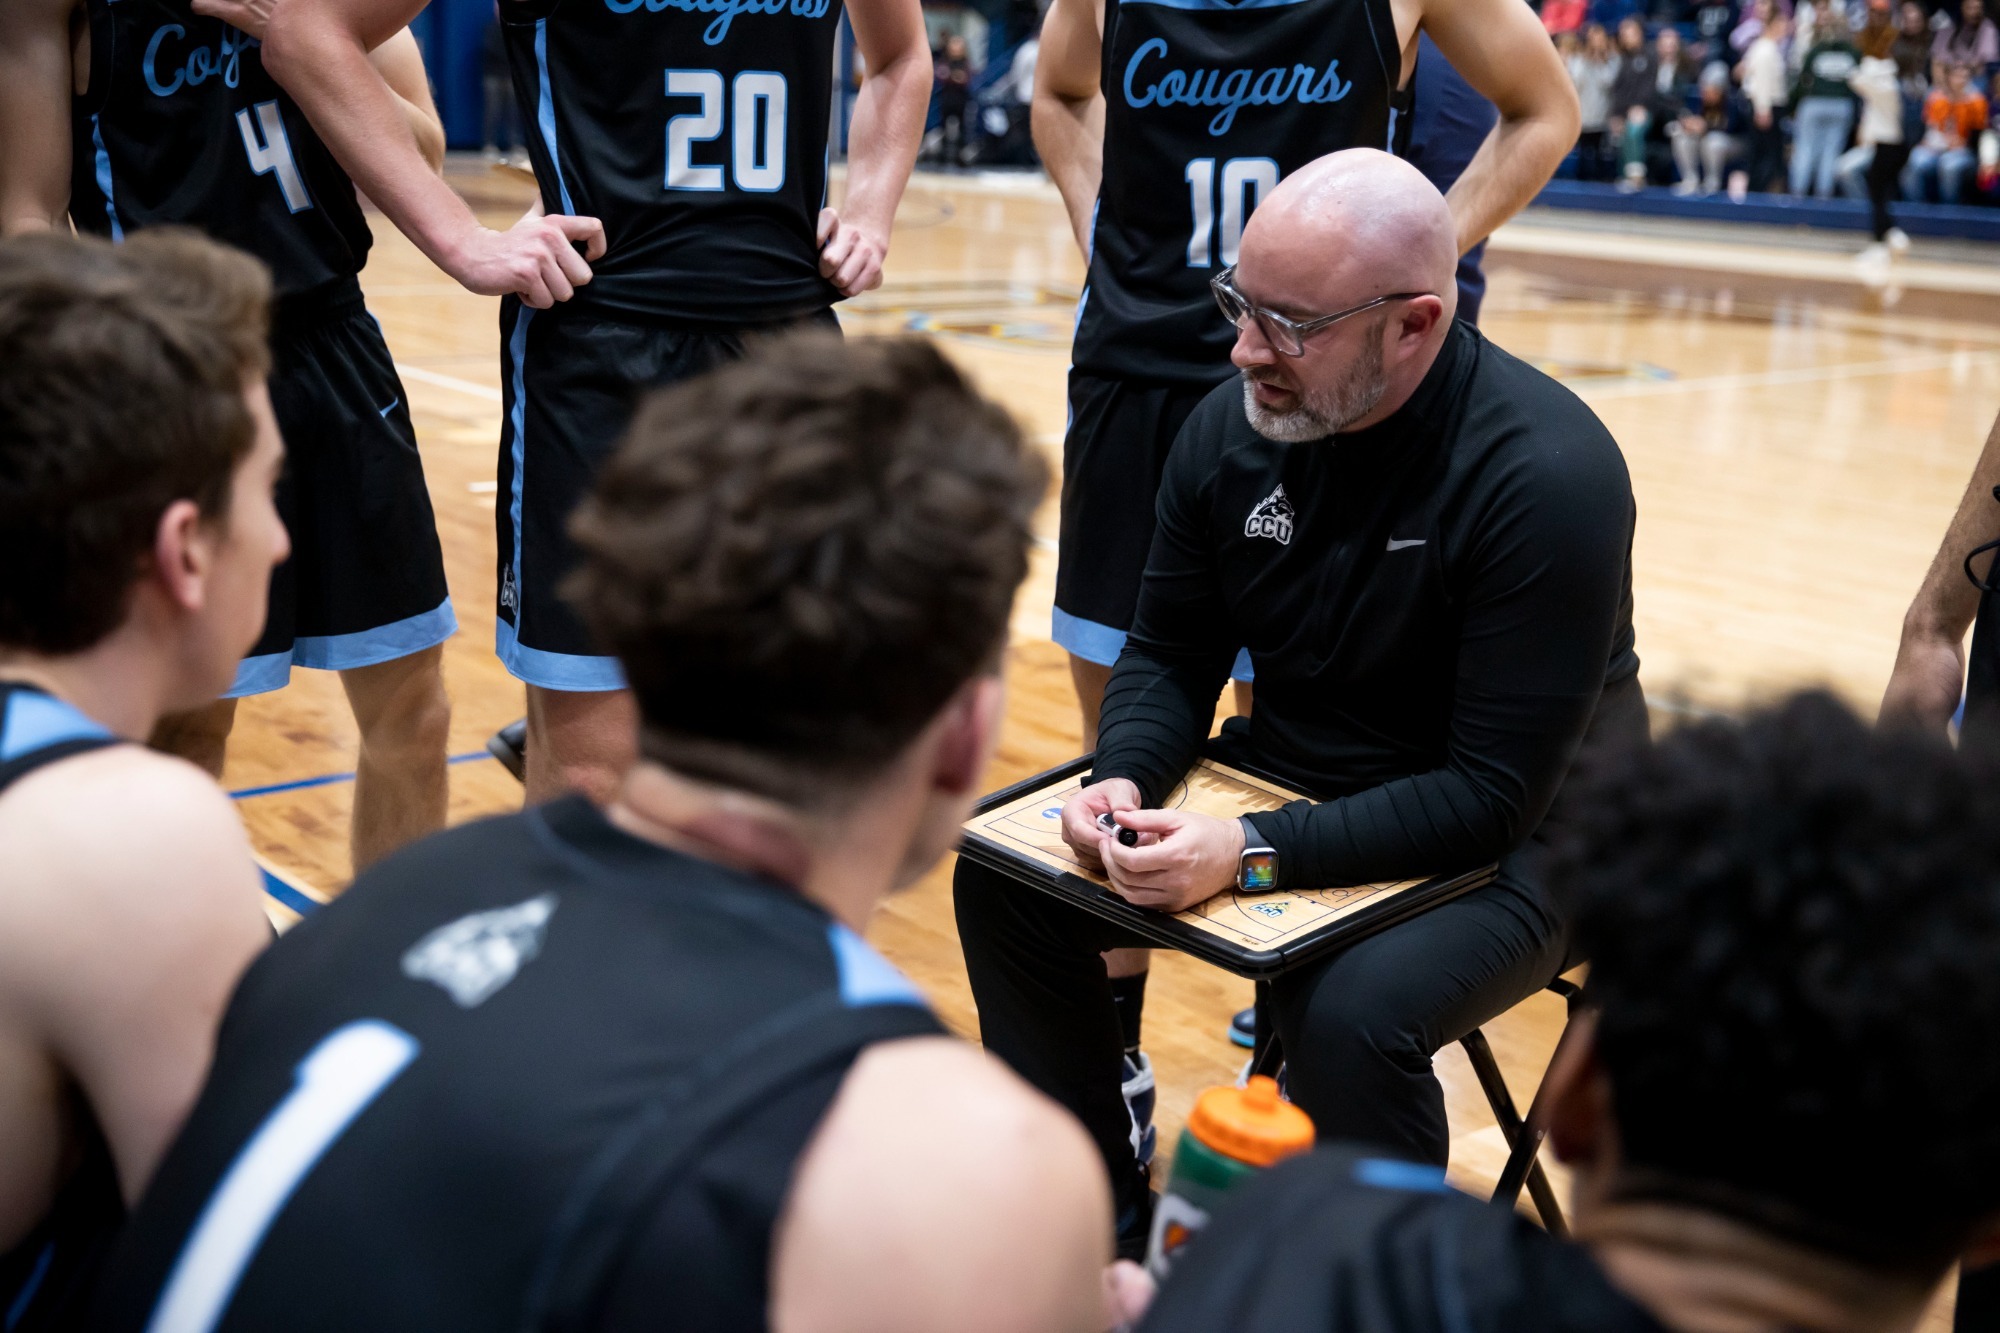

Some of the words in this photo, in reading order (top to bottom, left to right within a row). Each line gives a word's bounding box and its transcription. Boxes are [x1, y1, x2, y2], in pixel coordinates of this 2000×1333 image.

[665, 68, 788, 192] 20
[1123, 38, 1352, 136] Cougars
[235, 99, 314, 214] 4
[1185, 157, 1280, 268] 10
[1246, 515, 1292, 544] CCU
[143, 1018, 421, 1333] 1
